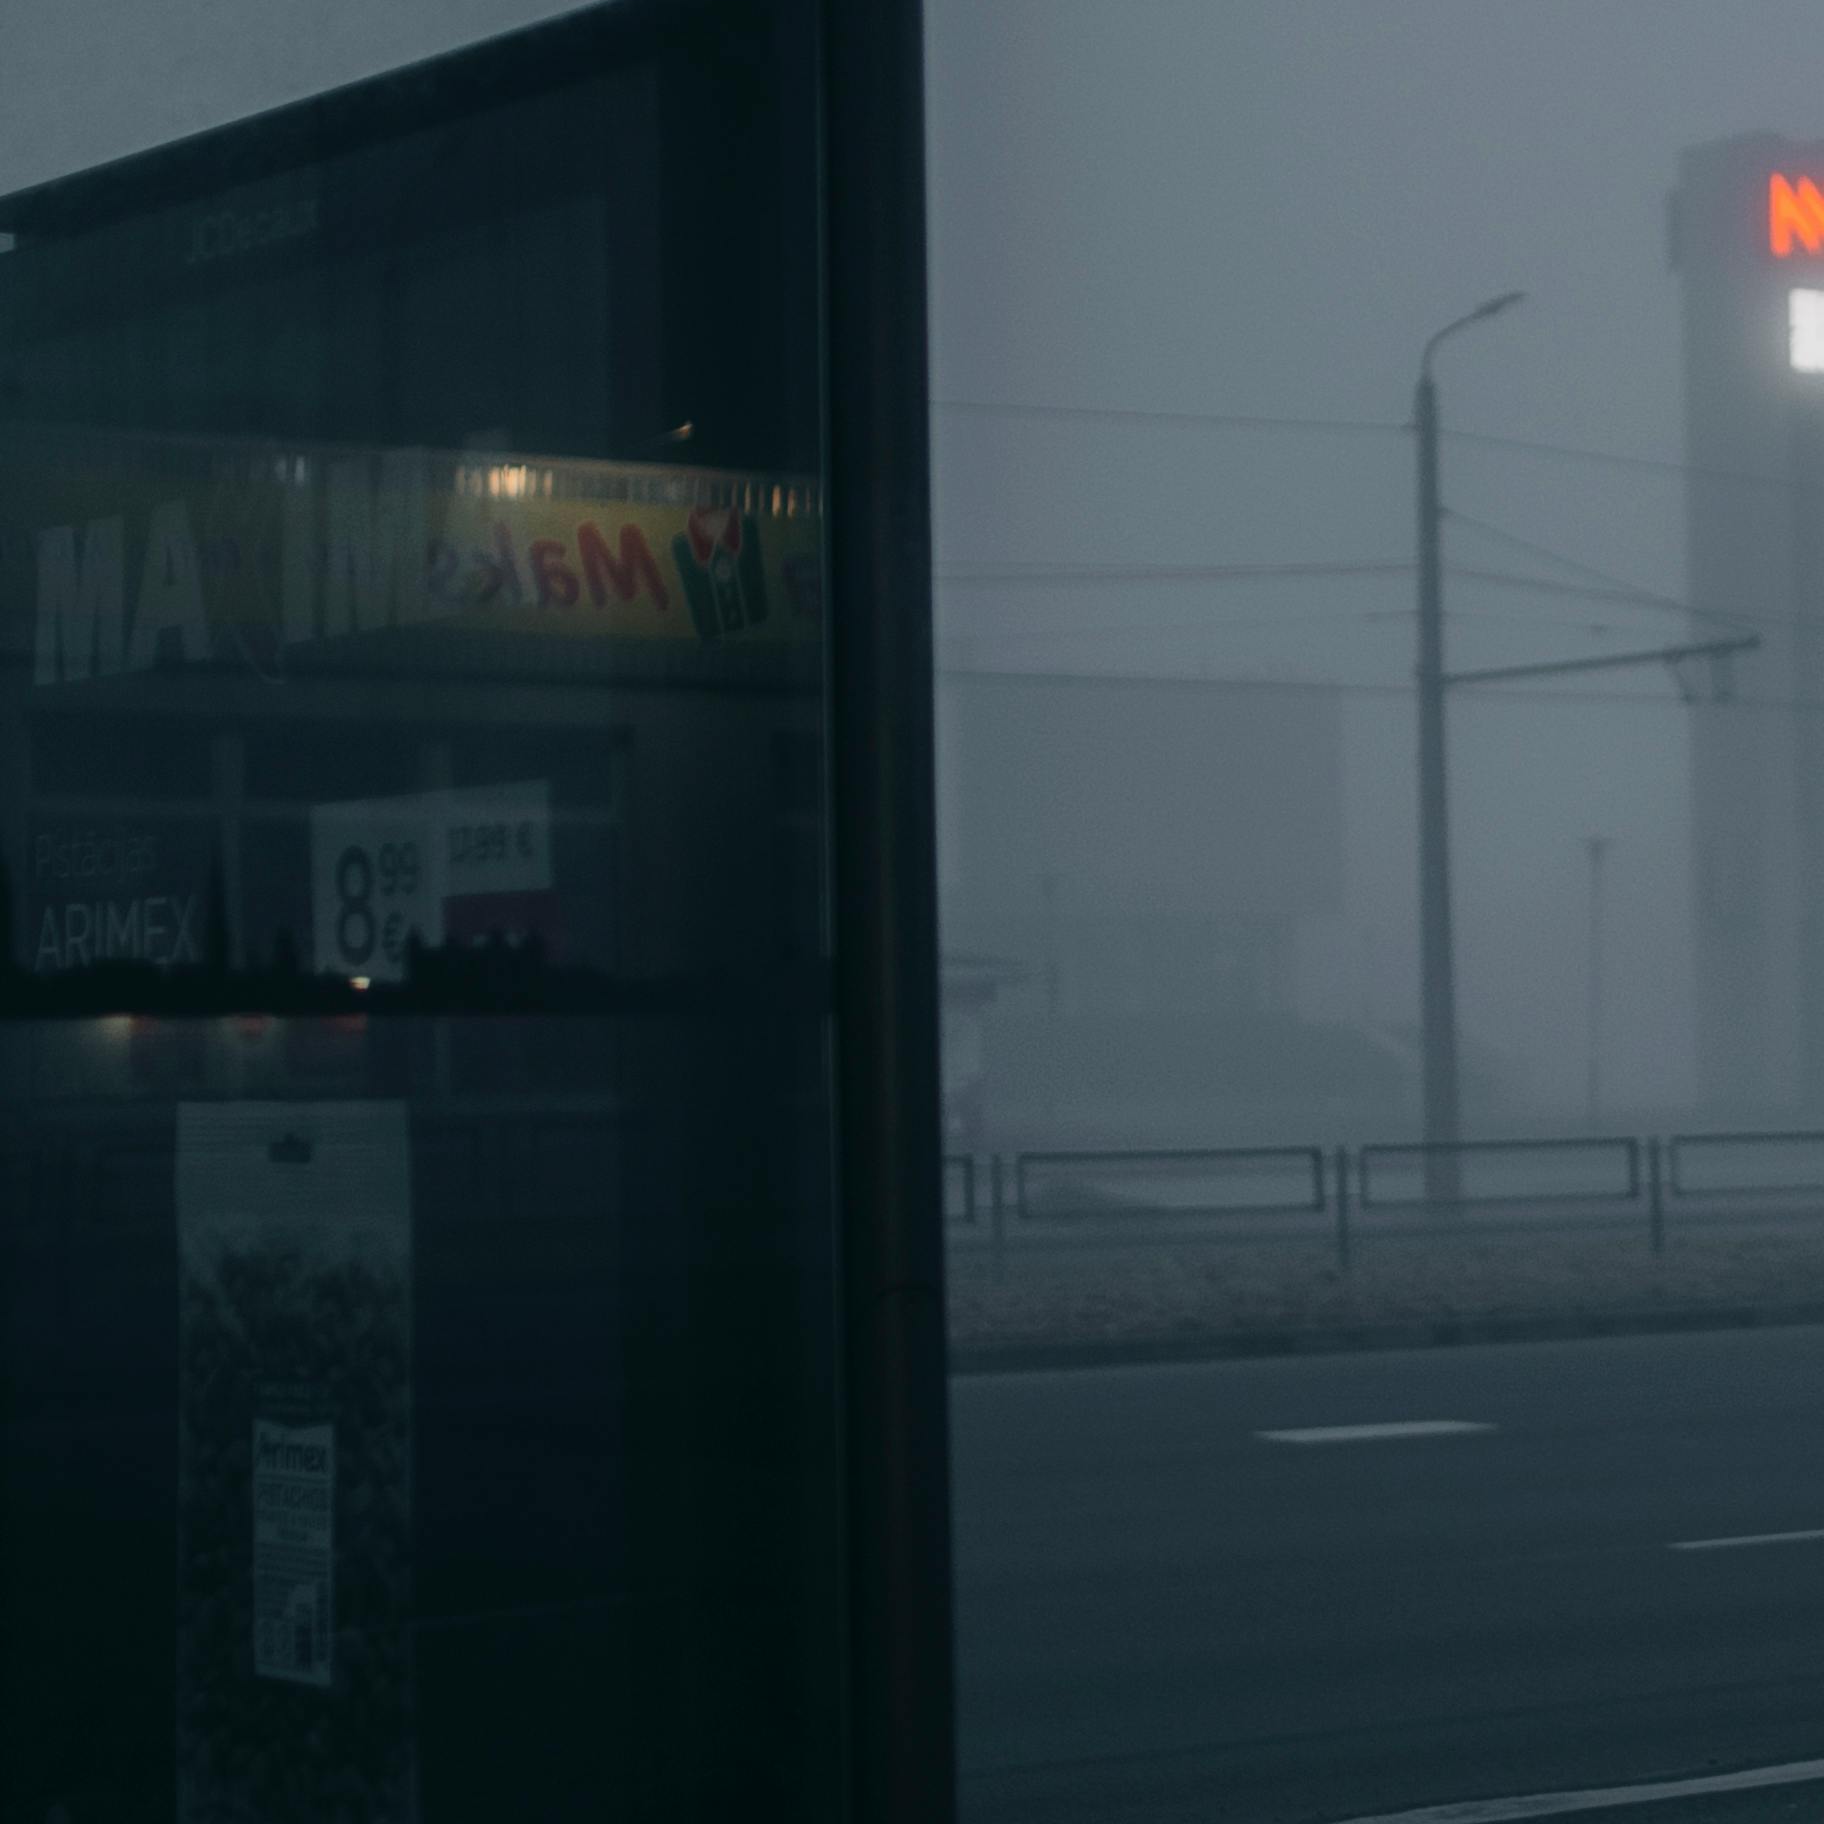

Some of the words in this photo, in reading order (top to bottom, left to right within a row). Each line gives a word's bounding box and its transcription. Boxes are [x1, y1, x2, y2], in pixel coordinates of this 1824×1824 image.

[34, 892, 195, 972] ARIMEX
[335, 845, 376, 966] 8
[379, 841, 419, 896] 99
